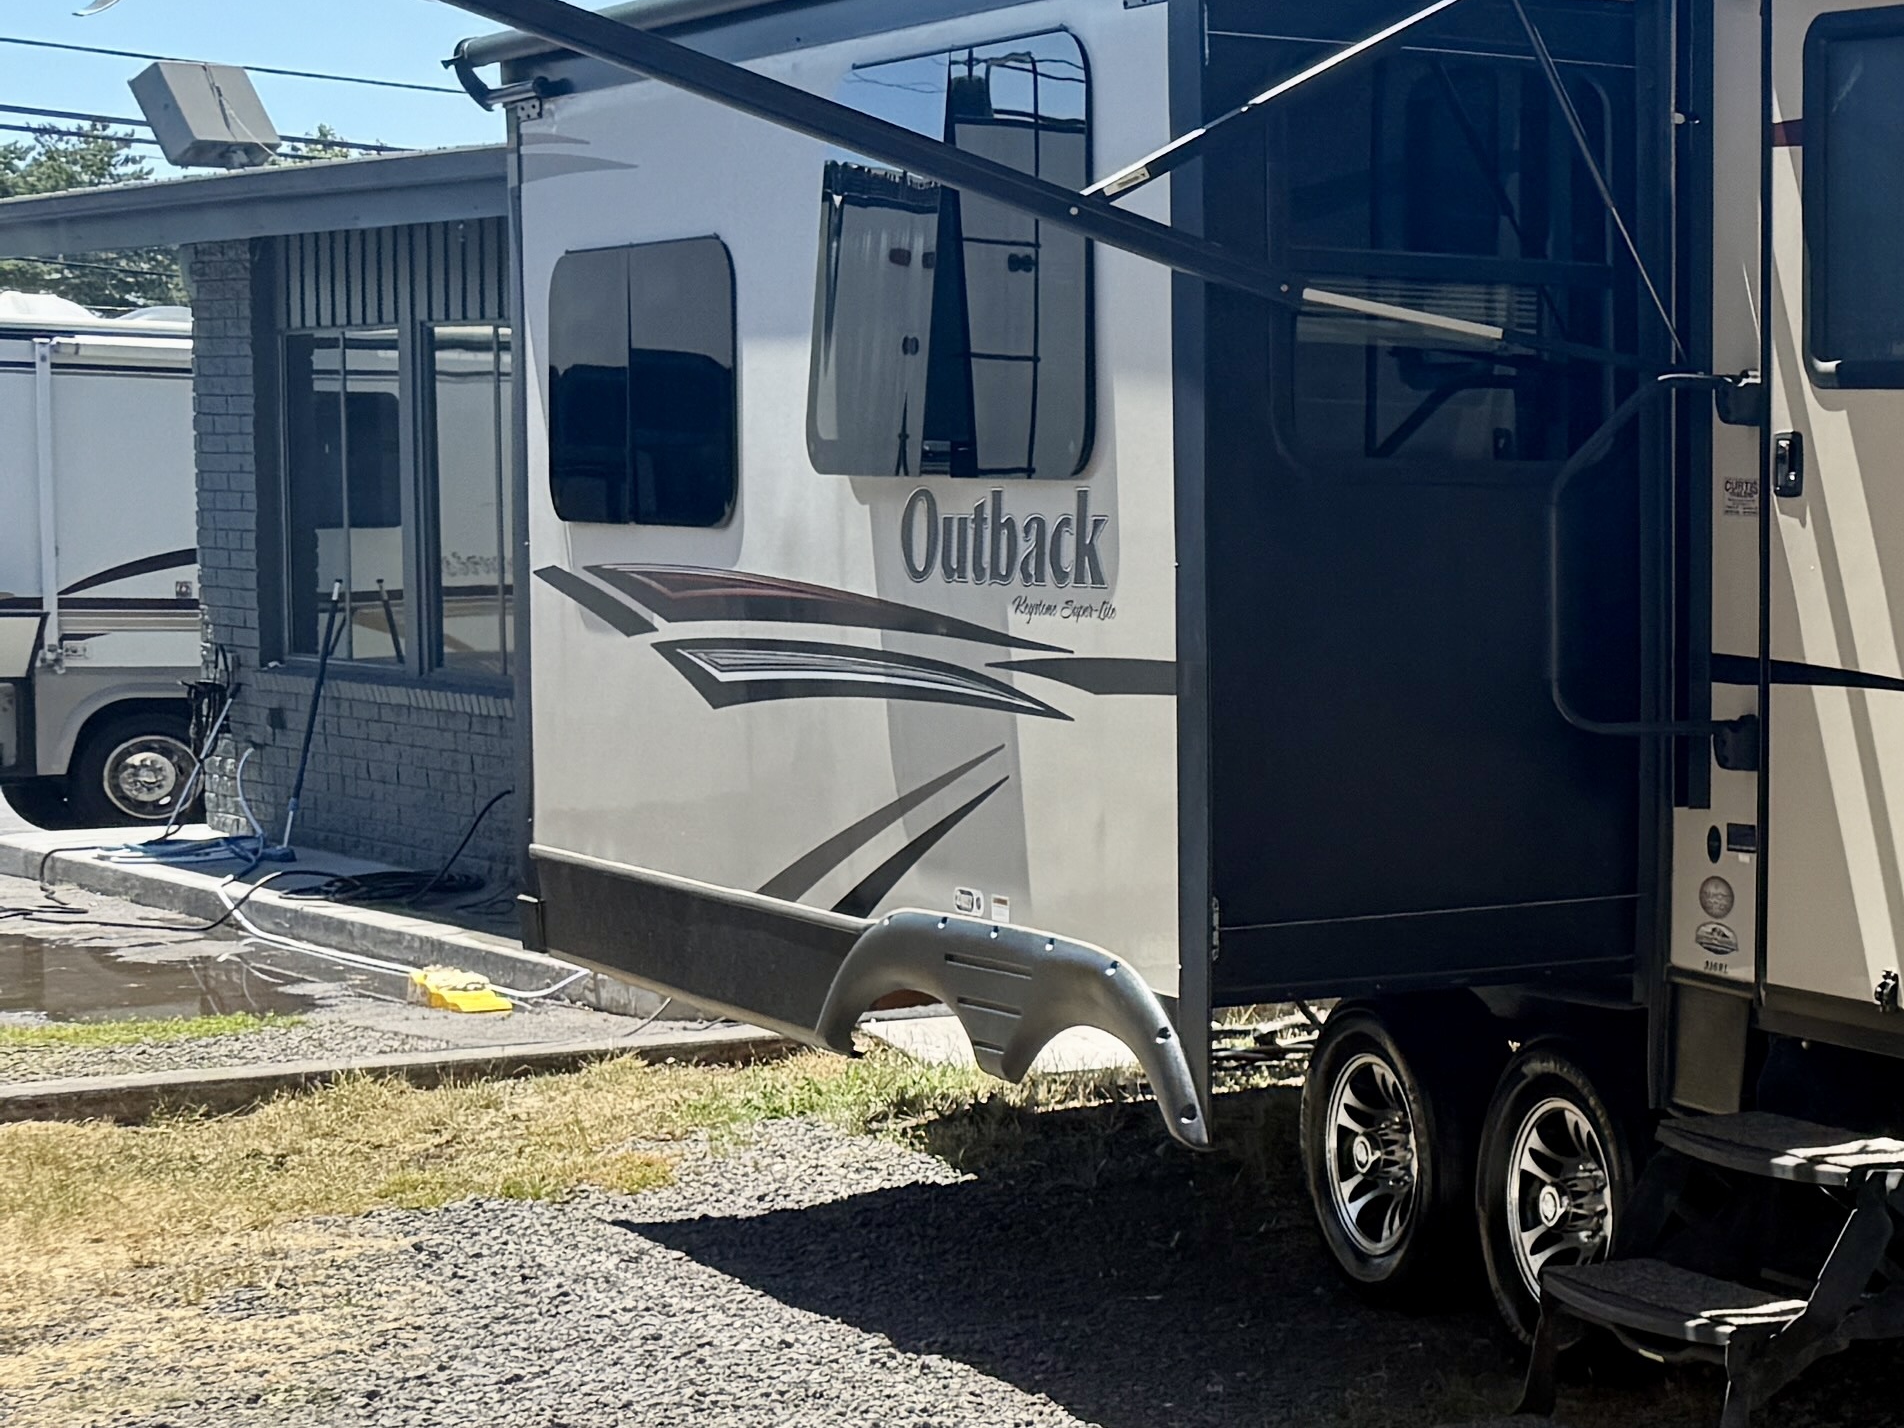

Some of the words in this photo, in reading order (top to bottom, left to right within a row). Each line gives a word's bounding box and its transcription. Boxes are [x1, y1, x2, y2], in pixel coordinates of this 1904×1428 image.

[901, 486, 1109, 589] Outback
[1012, 595, 1057, 625] Keystone
[1060, 599, 1117, 623] Super-Lite
